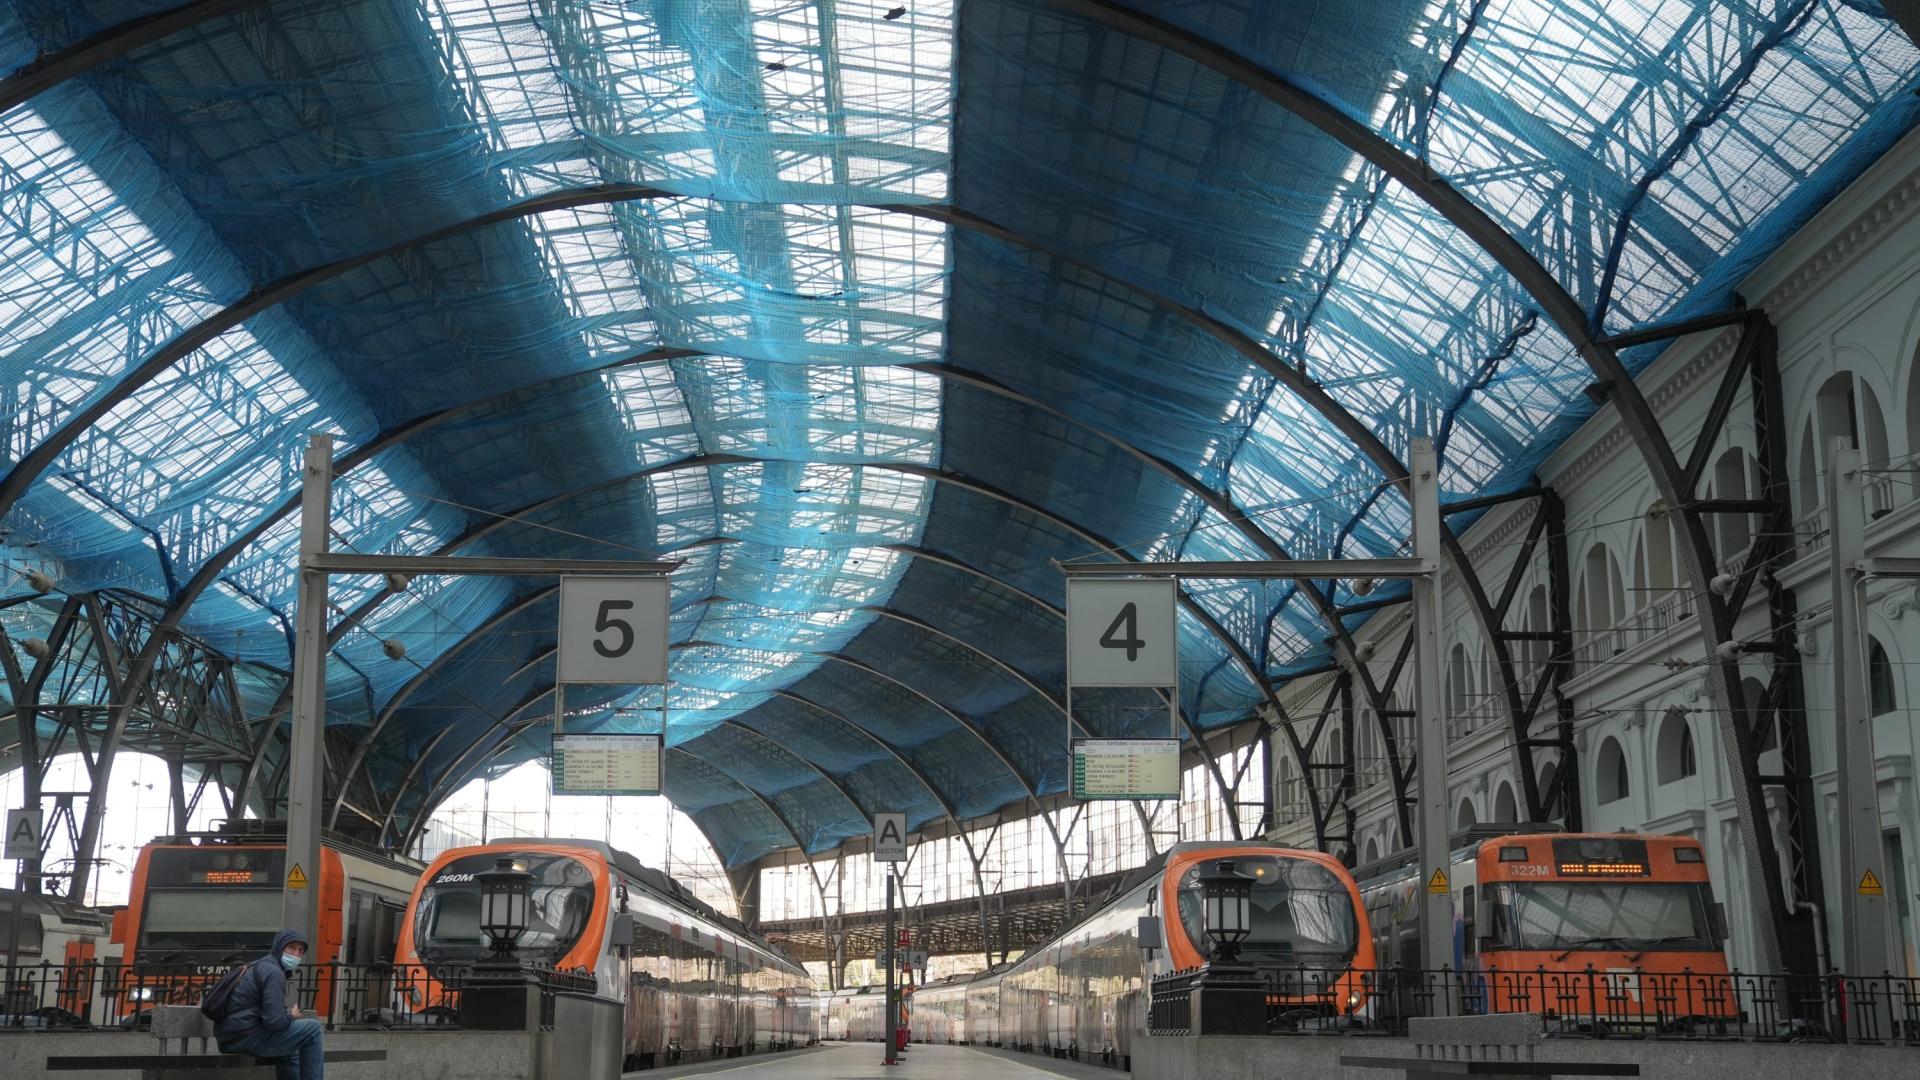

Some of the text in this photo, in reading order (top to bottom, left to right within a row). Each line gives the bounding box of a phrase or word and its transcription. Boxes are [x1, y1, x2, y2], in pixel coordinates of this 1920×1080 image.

[592, 599, 635, 659] 5
[1099, 601, 1146, 662] 4
[11, 816, 34, 842] A
[879, 819, 902, 844] A
[435, 873, 474, 884] 260M
[1511, 864, 1549, 876] 322M
[913, 954, 922, 966] 4
